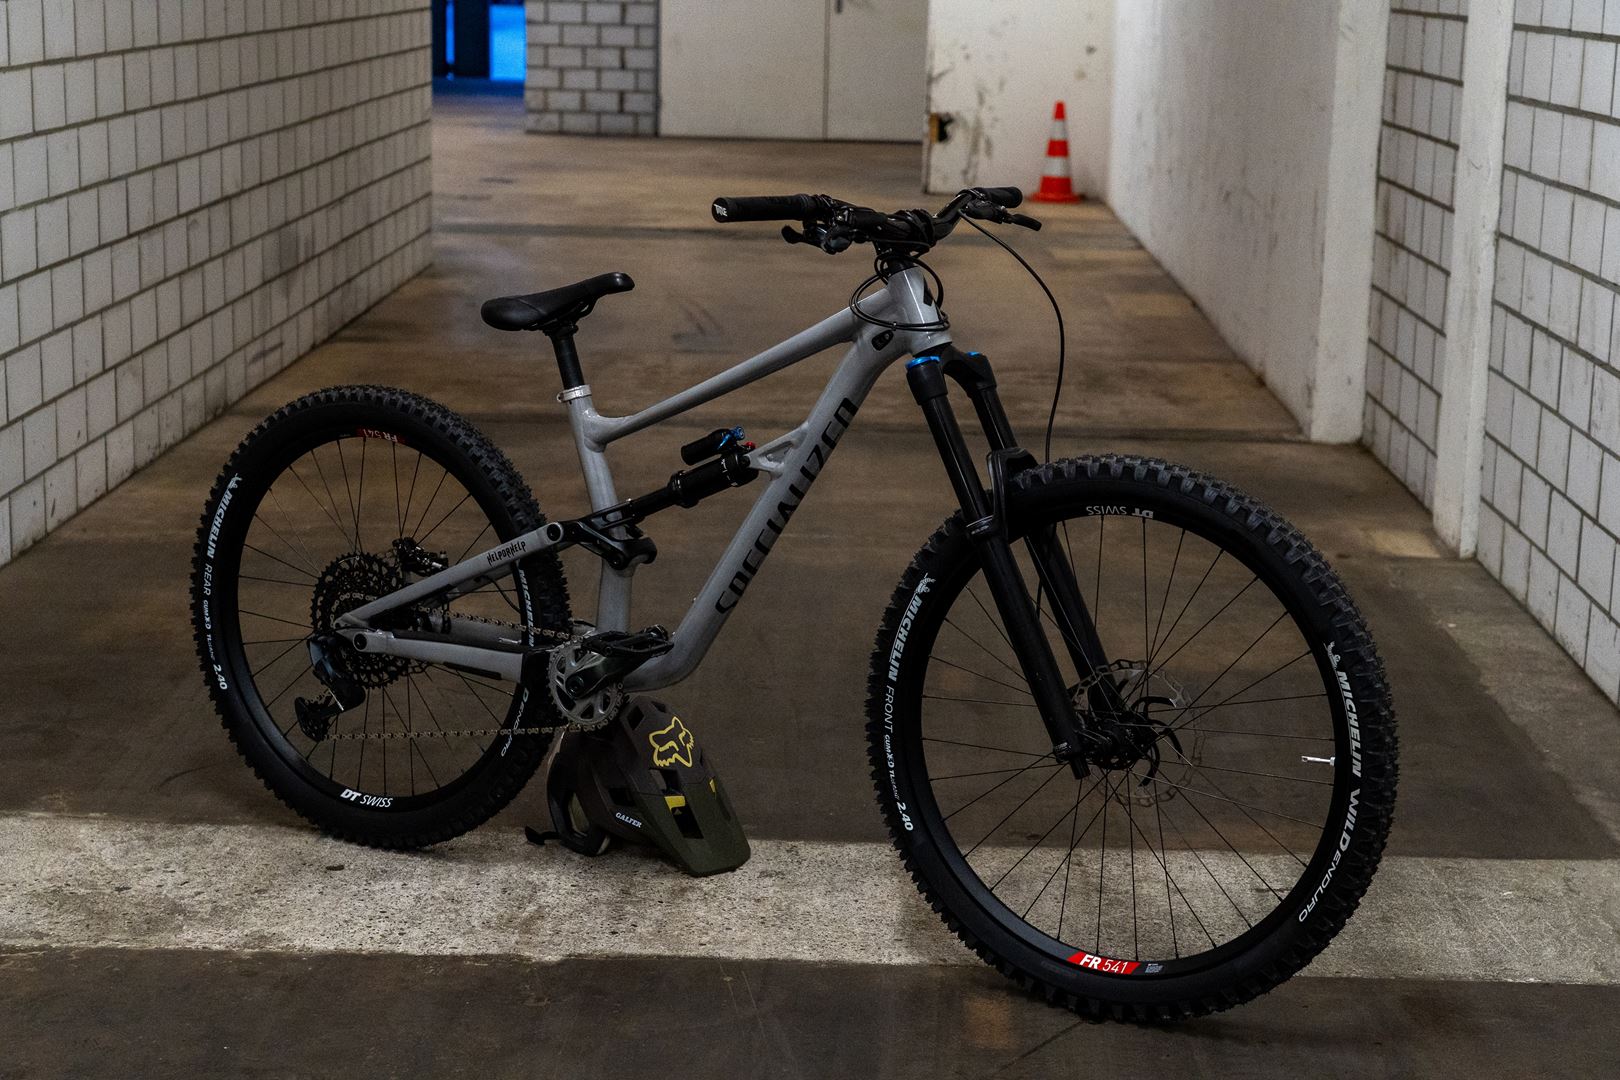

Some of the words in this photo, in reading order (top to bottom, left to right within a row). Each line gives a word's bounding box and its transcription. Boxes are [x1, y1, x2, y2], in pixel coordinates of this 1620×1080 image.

[207, 488, 233, 559] MICHELIN
[1086, 505, 1127, 516] SWISS
[1132, 507, 1154, 519] DT
[203, 562, 213, 596] REAR
[887, 593, 923, 682] MICHELIN
[213, 663, 228, 690] 2.40
[884, 685, 895, 734] FRONT
[1336, 670, 1362, 778] MICHELIN
[340, 788, 362, 801] DT
[360, 794, 393, 808] SWISS
[615, 811, 642, 828] GALFER
[897, 801, 914, 832] 2.40
[1339, 788, 1360, 852] WILD
[1298, 849, 1341, 922] ENDURO
[1079, 953, 1101, 970] FR
[1102, 959, 1128, 974] 541
